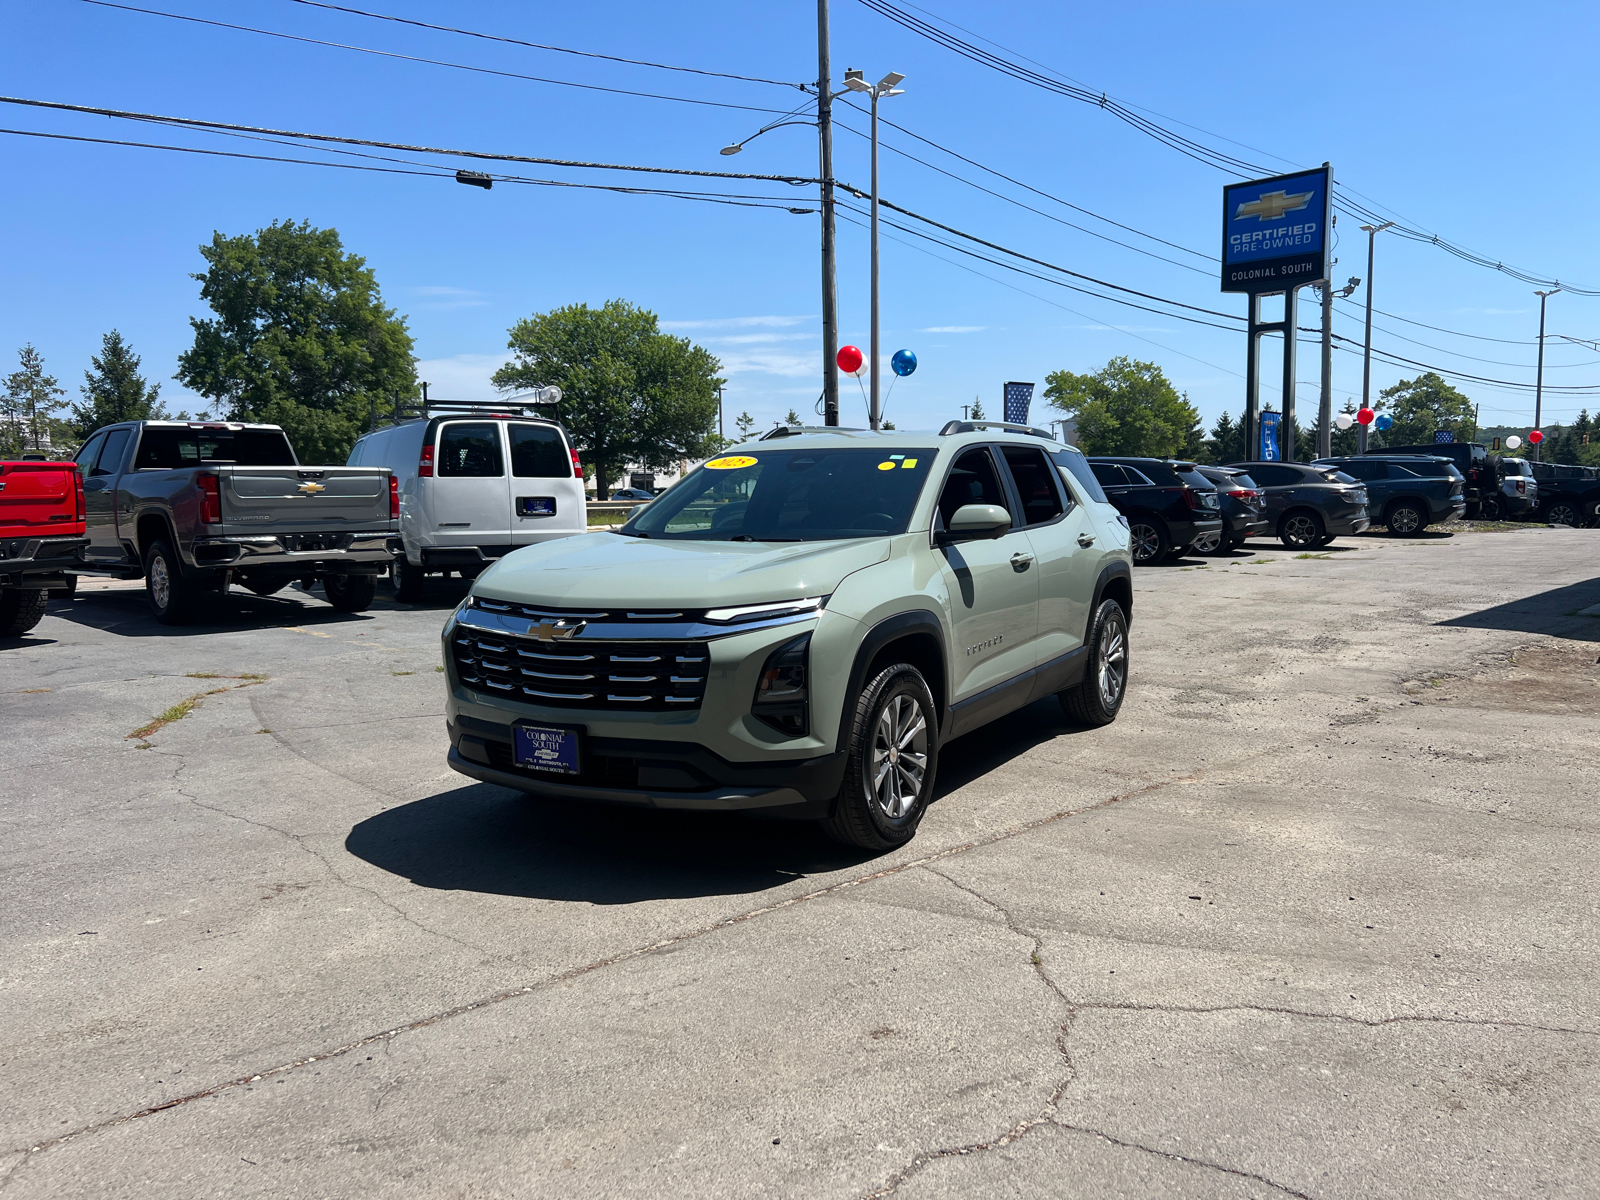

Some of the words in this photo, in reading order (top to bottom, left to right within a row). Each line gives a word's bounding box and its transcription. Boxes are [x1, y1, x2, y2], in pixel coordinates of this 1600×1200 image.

[1230, 223, 1316, 245] CERTIFIED
[1233, 234, 1312, 254] PRE-OWNED
[1231, 268, 1276, 281] COLONIAL
[1281, 262, 1312, 275] SOUTH
[526, 731, 565, 743] COLONIAL
[532, 740, 559, 750] SOUTH
